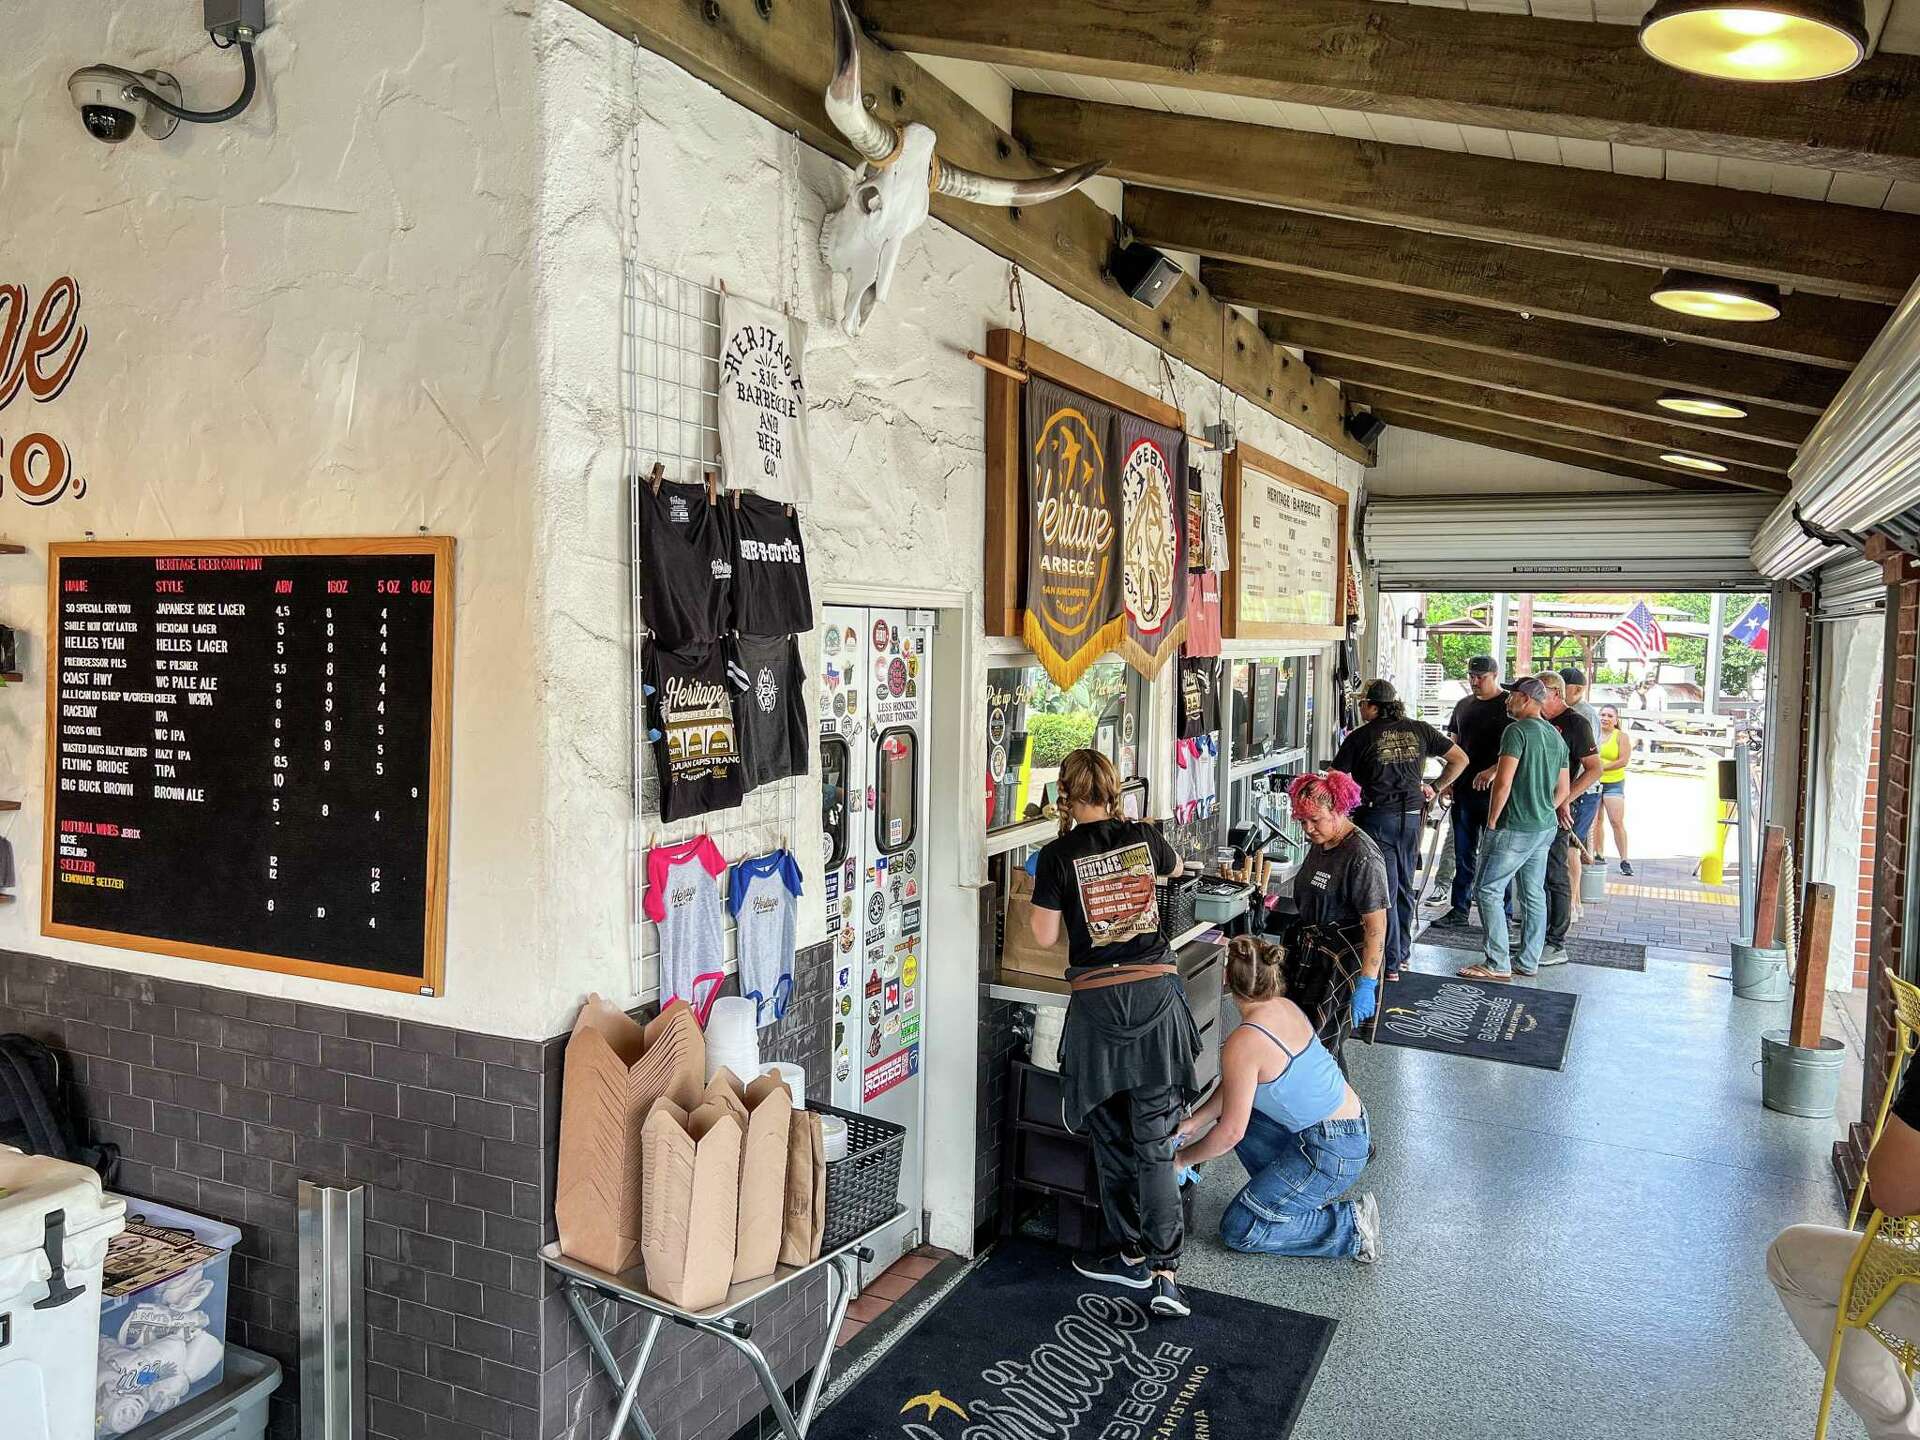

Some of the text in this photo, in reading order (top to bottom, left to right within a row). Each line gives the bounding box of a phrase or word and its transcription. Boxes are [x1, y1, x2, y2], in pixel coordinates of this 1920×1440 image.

[735, 380, 798, 419] BARBECUE
[759, 411, 779, 436] AND
[755, 430, 782, 460] BEER
[1266, 486, 1291, 511] HERITAGE
[1292, 495, 1321, 519] BARBECUE
[155, 557, 263, 571] HERITAGE BEER COMPANY
[155, 580, 184, 593] STYLE
[274, 580, 293, 594] ABV
[377, 580, 385, 594] 5
[386, 580, 400, 594] OZ
[411, 580, 418, 593] 8
[419, 580, 432, 594] OZ
[65, 603, 387, 619] SO SPECIAL FOR YOU JAPANESE RICE LAGER 4.5 8 4
[64, 621, 86, 631] SMILE
[102, 622, 116, 632] CRY
[116, 622, 138, 633] LATER
[156, 623, 188, 633] MEXICAN
[192, 624, 217, 634] LAGER
[277, 622, 285, 636] 5
[326, 622, 334, 637] 8
[379, 623, 387, 638] 4
[64, 636, 387, 655] HELLES YEAH HELLES LAGER 5 8 4
[110, 658, 127, 669] PILS
[155, 660, 167, 670] WC
[169, 660, 198, 671] PILSNER
[273, 663, 287, 675] 5.5
[326, 662, 334, 676] 8
[378, 663, 386, 678] 4
[63, 671, 386, 695] COAST HWY WC PALE ALE 5 8 4
[666, 676, 724, 712] Heritage
[154, 693, 177, 704] CHEEK
[325, 698, 333, 713] 9
[377, 701, 385, 715] 4
[877, 702, 893, 713] LESS
[63, 704, 97, 718] RACEDAY
[155, 710, 168, 722] IPA
[325, 719, 332, 732] 9
[378, 724, 384, 735] 5
[876, 712, 895, 723] MORE
[63, 724, 85, 735] LOCOS
[155, 729, 168, 740] WC
[170, 729, 185, 742] IPA
[324, 739, 331, 751] 9
[377, 744, 384, 755] 5
[62, 742, 87, 753] WASTED
[87, 744, 105, 755] DAYS
[105, 745, 124, 756] HAZY
[155, 748, 173, 760] HAZY
[177, 749, 191, 761] IPA
[324, 760, 330, 771] 9
[376, 762, 383, 775] 5
[62, 757, 418, 798] FLYING BRIDGE TIPA 10 9
[61, 777, 381, 822] BIG BUCK BROWN BROWN ALE 5 8 4
[61, 819, 96, 835] NATURAL
[60, 834, 381, 879] ROSE 12 12
[60, 858, 96, 873] SELTZER
[1078, 853, 1123, 878] HERITAGE
[269, 868, 278, 880] 12
[61, 872, 95, 886] LEMONADE
[95, 876, 125, 890] SELTZER
[368, 917, 376, 929] 4
[864, 1063, 902, 1094] RODEO
